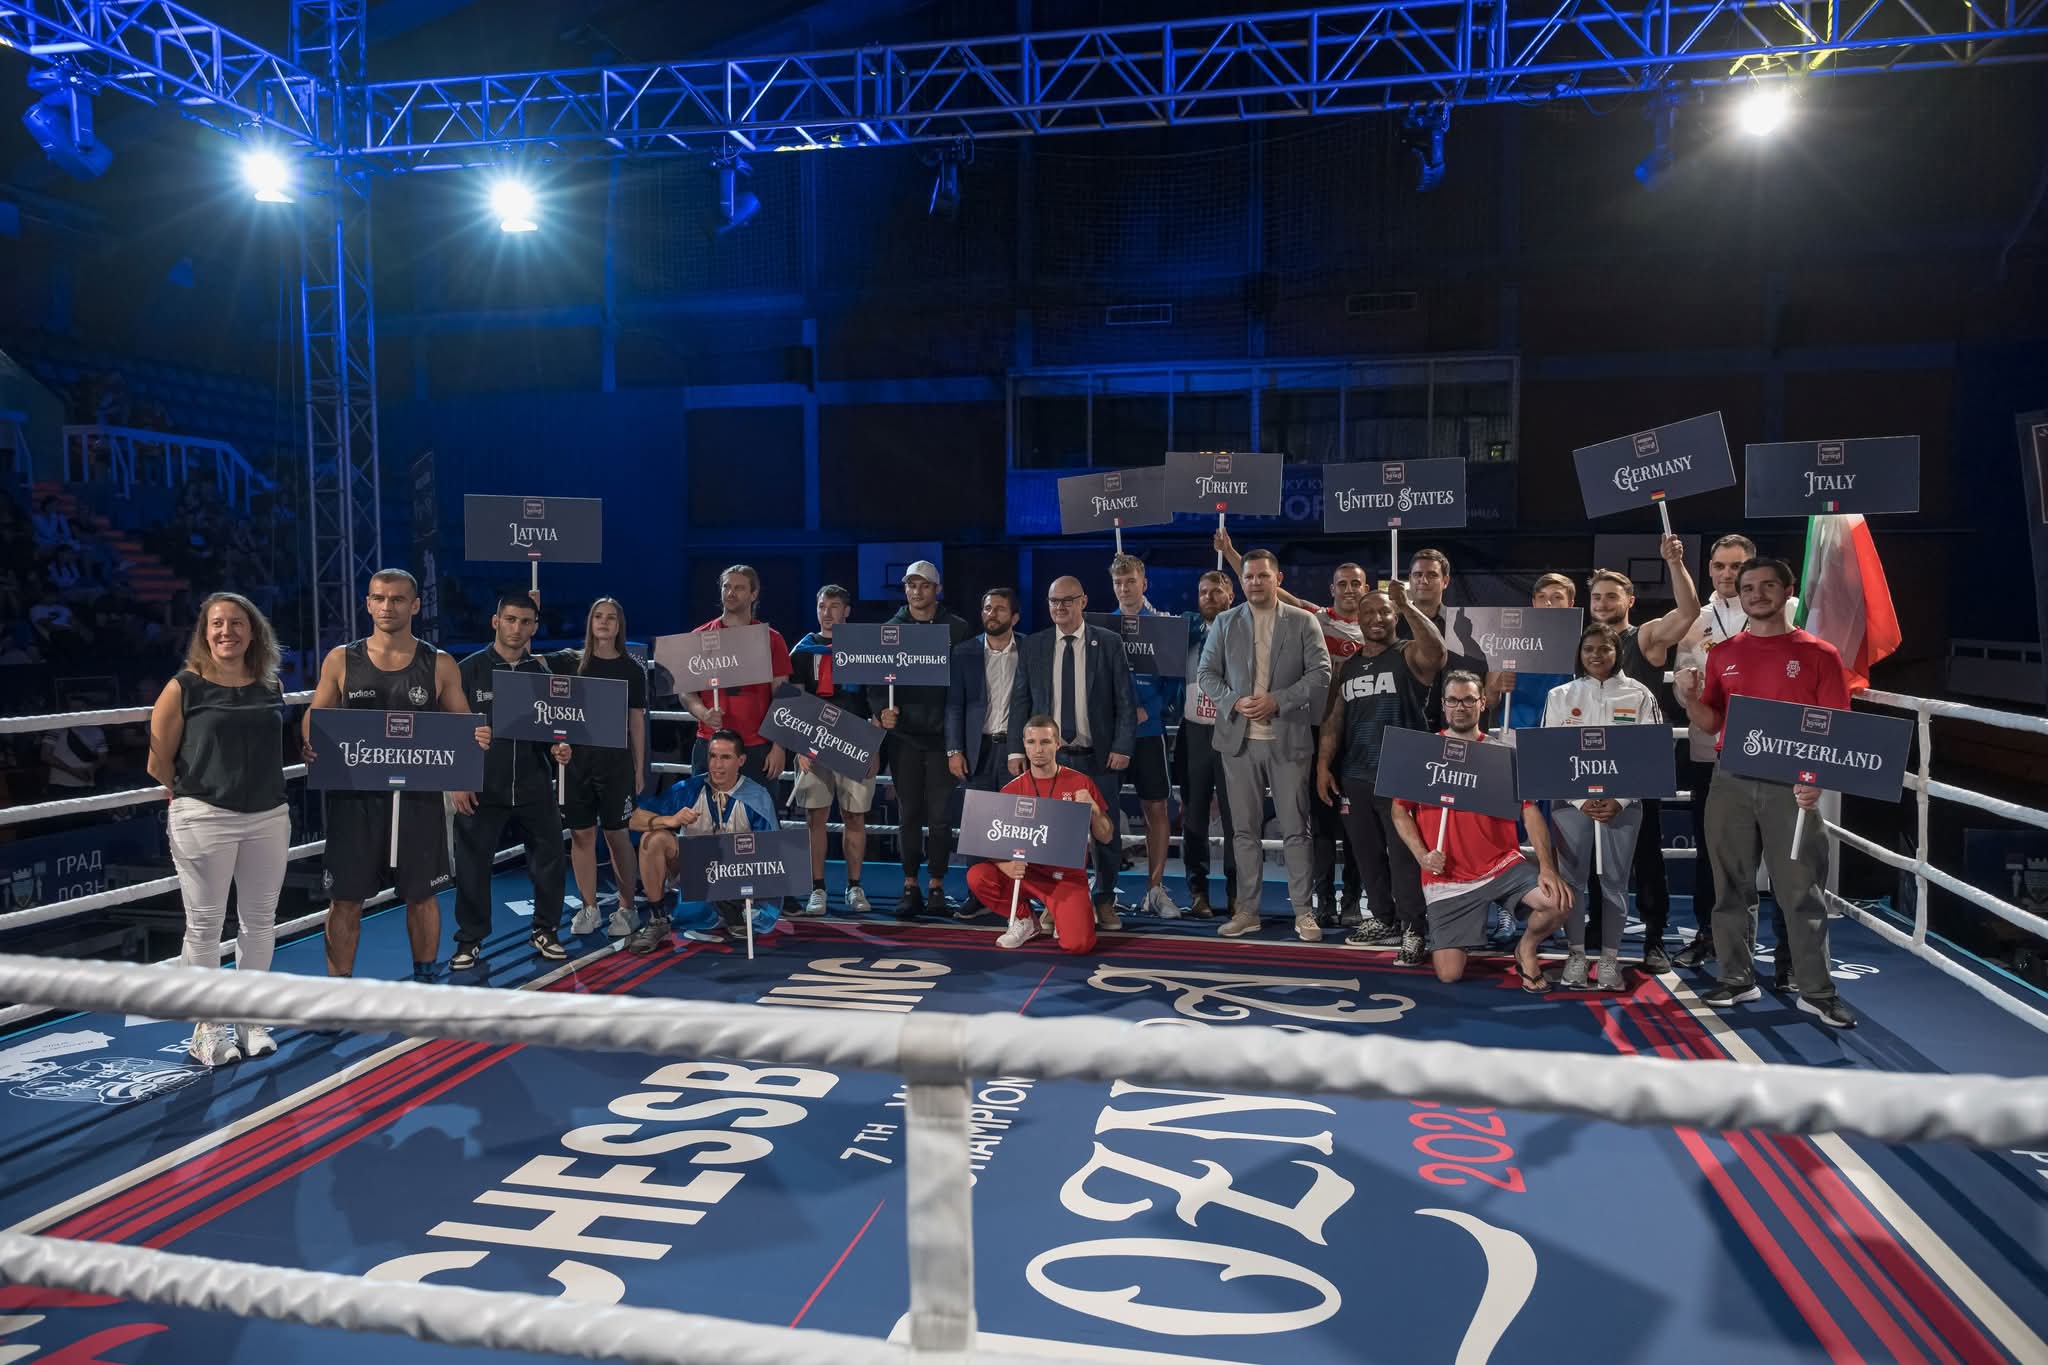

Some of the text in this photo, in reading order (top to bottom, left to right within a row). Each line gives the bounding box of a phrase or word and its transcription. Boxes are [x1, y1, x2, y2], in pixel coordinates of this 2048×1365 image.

[1613, 455, 1692, 492] GERMANY
[1804, 471, 1856, 498] ITALY
[1091, 496, 1138, 517] FRANCE
[1335, 488, 1394, 512] UNITED
[1398, 487, 1454, 512] STATES
[509, 522, 558, 548] LATVIA
[1122, 641, 1155, 655] TONIA
[1479, 632, 1543, 657] GEORGIA
[688, 654, 739, 675] CANADA
[835, 651, 947, 668] DOMINICAN REPUBLIC
[1342, 672, 1397, 702] USA
[534, 700, 585, 725] RUSSIA
[773, 707, 813, 736] CZECH
[812, 725, 870, 764] REPUBLIC
[339, 739, 455, 767] UZBEKISTAN
[1743, 729, 1882, 771] SWITZERLAND
[1425, 761, 1478, 789] TAHITI
[1569, 755, 1619, 781] INDIA
[987, 819, 1049, 847] SERBIA
[705, 860, 785, 883] ARGENTINA
[362, 957, 952, 1305] CHESSBING
[1407, 1099, 1527, 1193] 202
